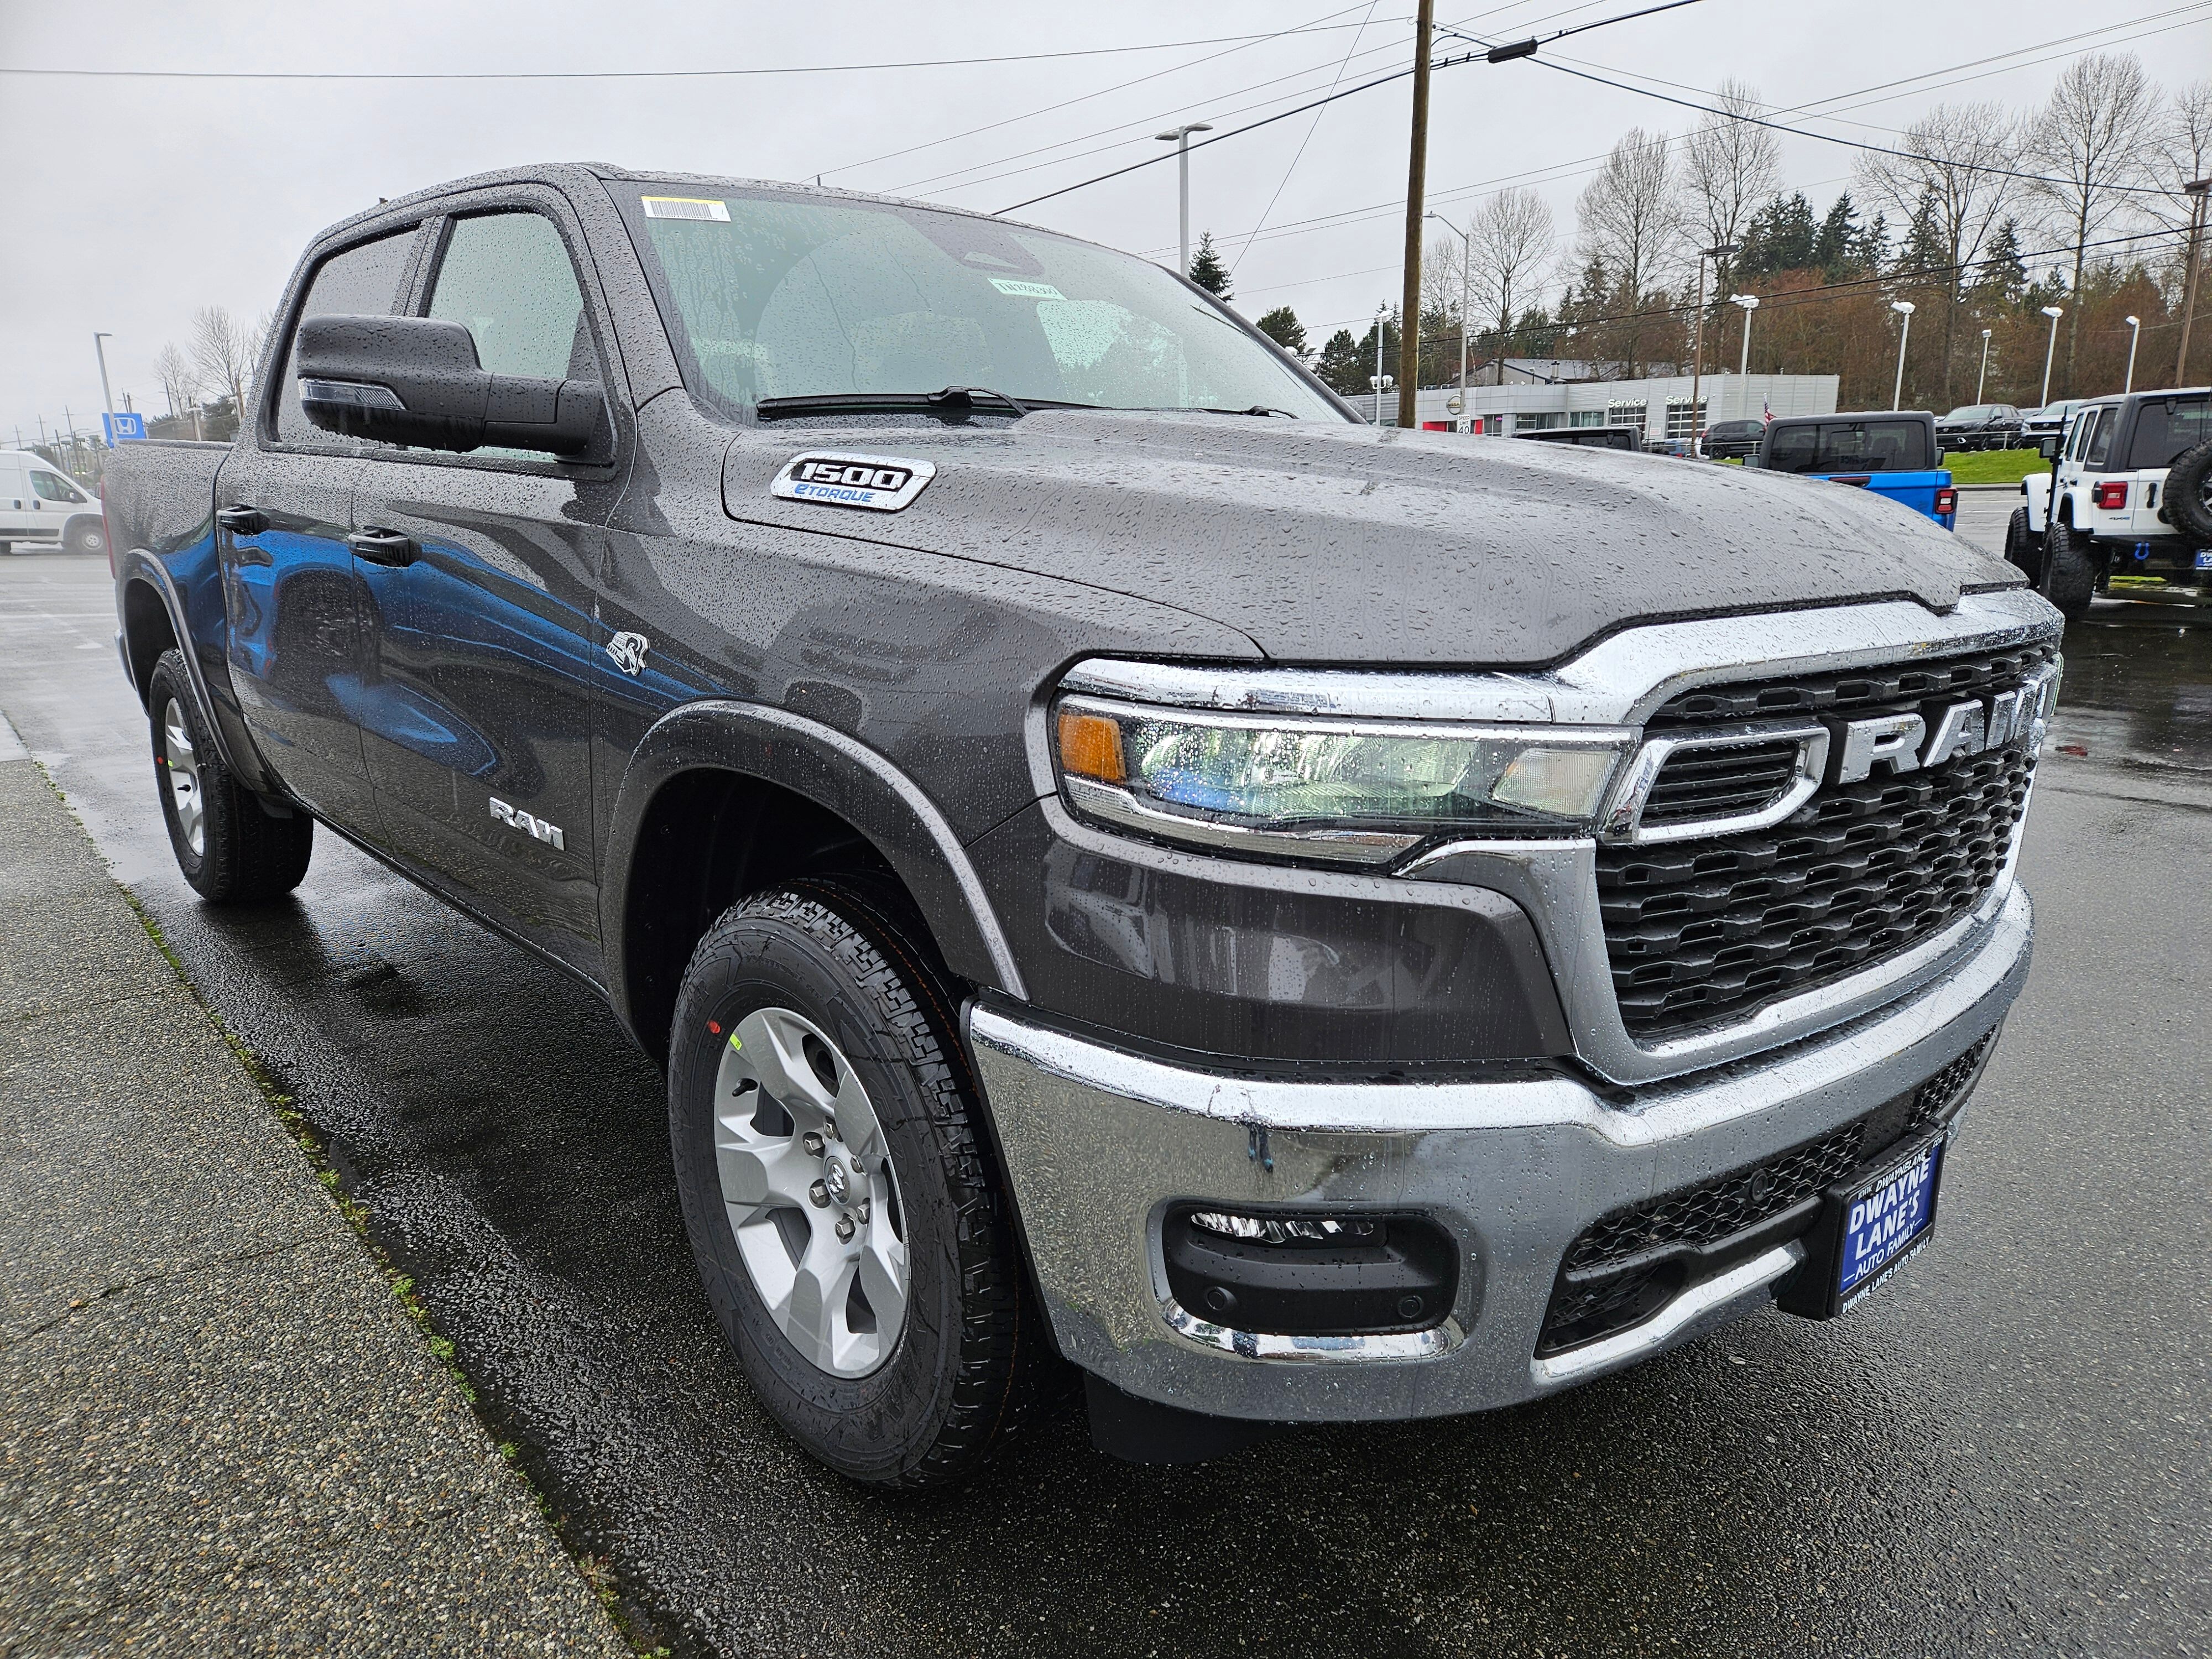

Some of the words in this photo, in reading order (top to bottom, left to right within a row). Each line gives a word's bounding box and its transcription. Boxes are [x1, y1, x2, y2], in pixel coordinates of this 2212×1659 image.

[1458, 426, 1469, 434] 40
[1608, 398, 1647, 408] Service
[800, 463, 907, 489] 1500
[1839, 682, 2047, 784] RAM
[489, 796, 565, 851] RAM
[1849, 1157, 1931, 1235] DWAYNE
[1875, 1148, 1927, 1192] DWAYNELANE
[1855, 1190, 1920, 1260] LANE'S
[1855, 1249, 1885, 1280] AUTO
[1887, 1220, 1915, 1256] FAMILY
[1843, 1286, 1870, 1314] DWAYNE
[1872, 1268, 1893, 1291] LANE'S
[1893, 1255, 1909, 1274] AUTO
[1910, 1236, 1930, 1261] FAMILY
